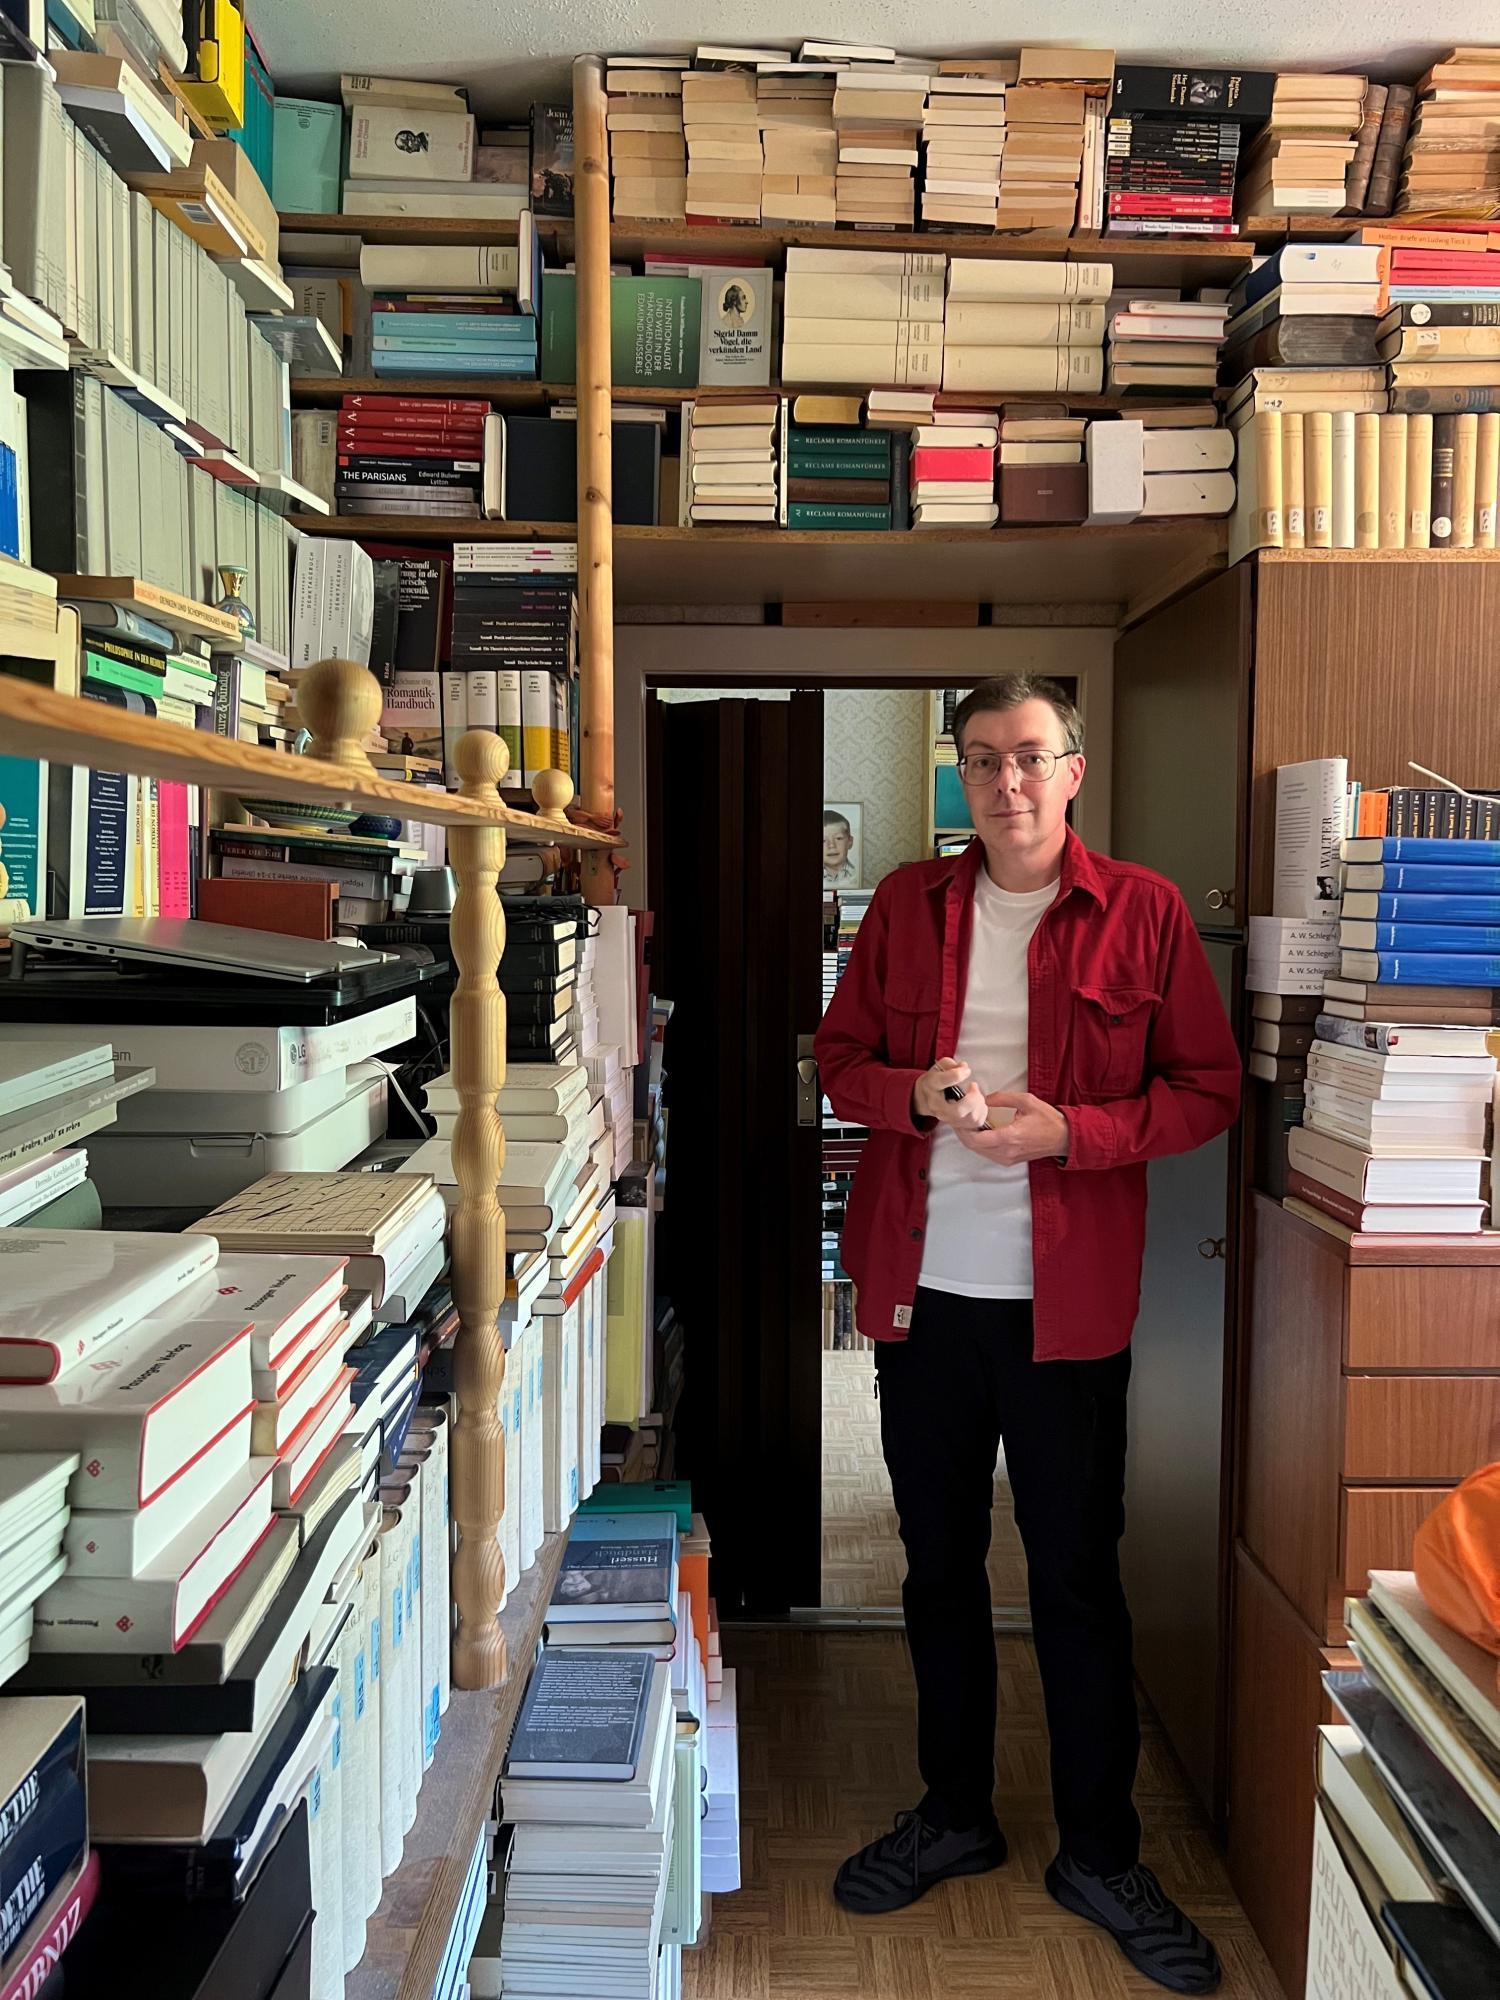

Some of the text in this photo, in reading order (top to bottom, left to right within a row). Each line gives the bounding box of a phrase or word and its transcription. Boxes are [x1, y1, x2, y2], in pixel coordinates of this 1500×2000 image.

[635, 293, 645, 375] EDMUND HUSSERLS
[654, 297, 664, 371] UND WELT IN DER
[713, 330, 735, 339] Sigrid
[745, 345, 762, 353] Land
[836, 437, 886, 445] ROMANFÜHRER
[343, 471, 407, 482] THE PARISIANS
[418, 471, 461, 479] Edward Bulwer
[837, 511, 887, 519] ROMANFÜHRER
[404, 561, 430, 569] Szondi
[418, 569, 439, 578] in die
[104, 641, 134, 661] PHILOSOPHIE
[134, 650, 140, 662] IN
[217, 671, 230, 703] bündig
[387, 686, 436, 698] Romantik-
[216, 704, 229, 713] &
[386, 698, 435, 710] Handbuch
[1331, 796, 1341, 860] BENJAMIN
[1320, 816, 1333, 869] WALTER
[297, 1044, 306, 1059] LG
[0, 1149, 17, 1163] rrida
[244, 1273, 297, 1312] Passagen Verlag
[119, 1343, 193, 1391] Passagen Verlag
[594, 1549, 658, 1558] Handbuch
[611, 1556, 658, 1564] Husserl
